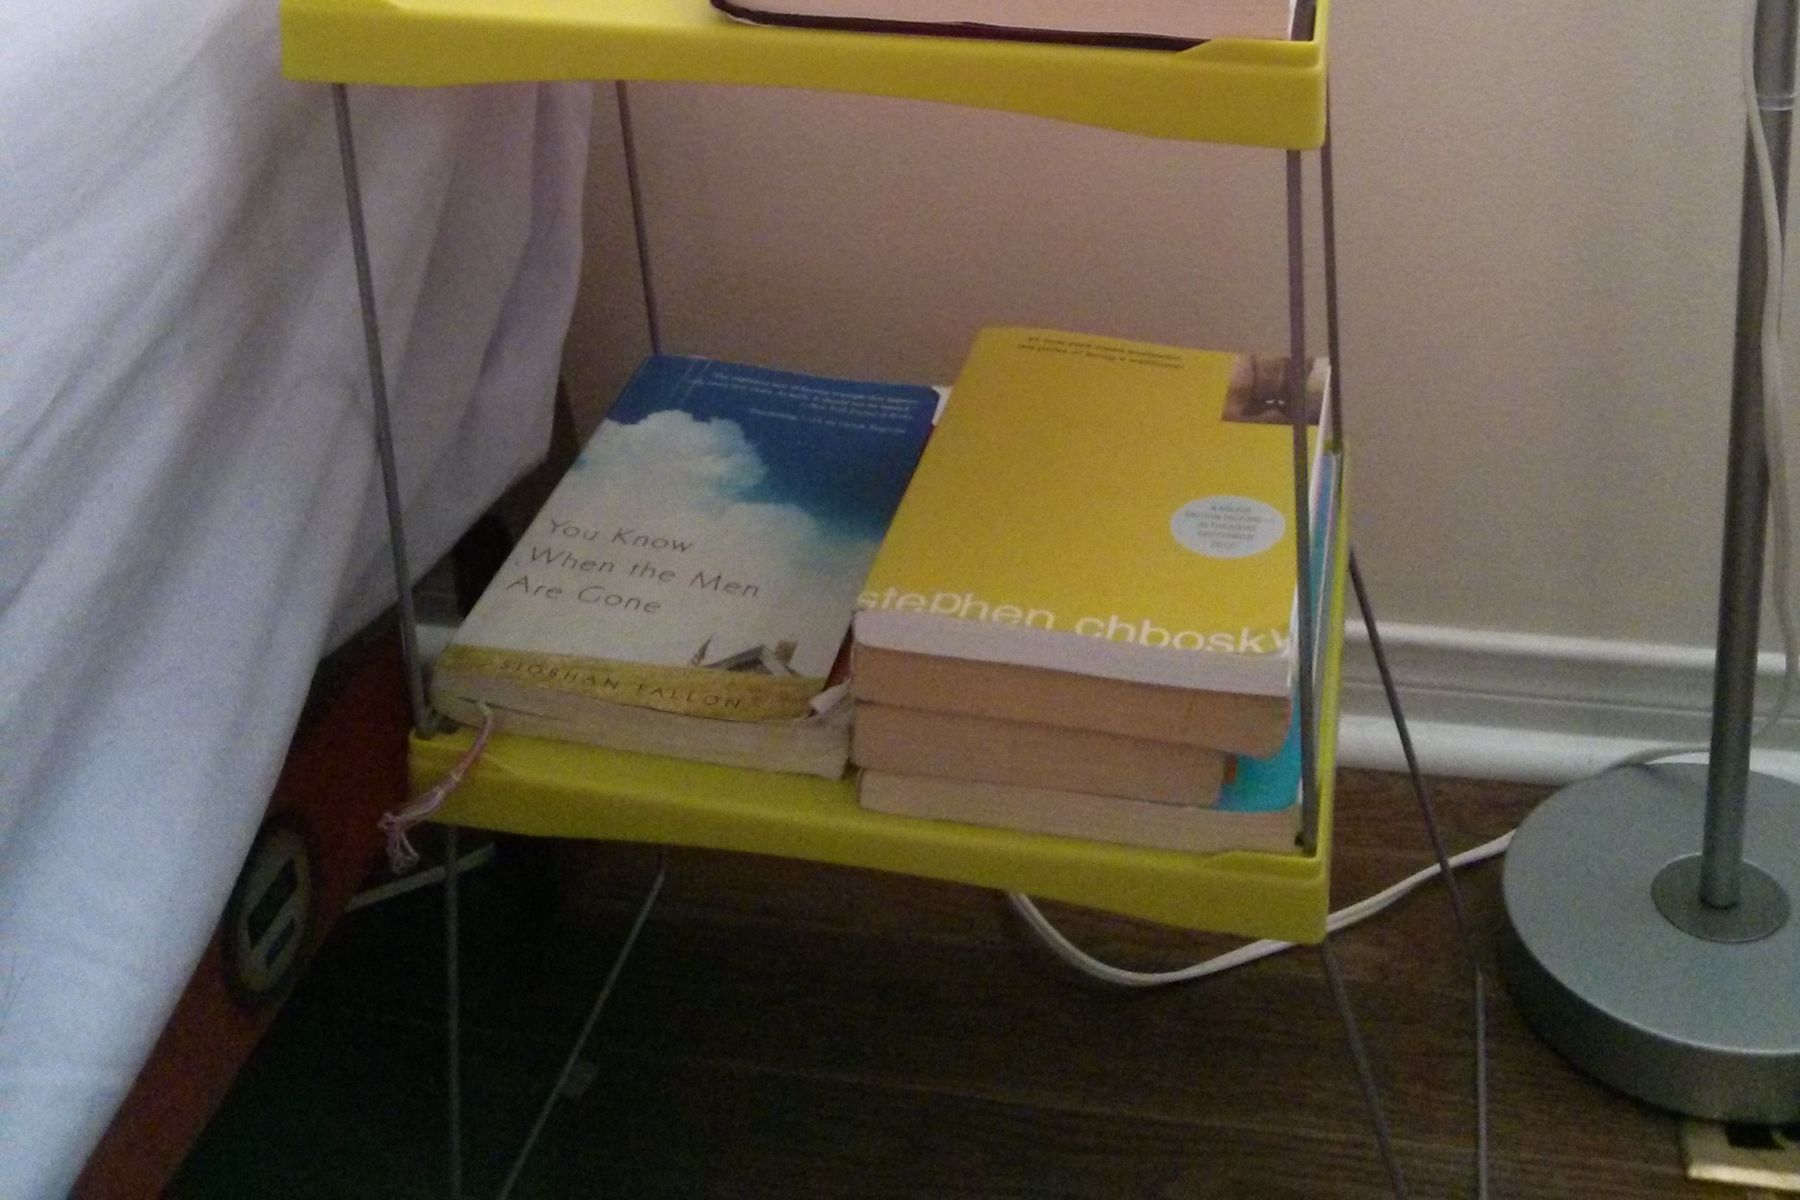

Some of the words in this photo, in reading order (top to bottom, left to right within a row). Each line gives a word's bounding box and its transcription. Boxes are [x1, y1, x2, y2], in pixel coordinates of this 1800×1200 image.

[550, 519, 599, 542] You
[611, 528, 693, 552] Know
[530, 546, 615, 573] When
[629, 563, 677, 583] the
[689, 571, 761, 598] Men
[506, 575, 563, 600] Are
[578, 585, 662, 614] Gone
[856, 587, 1056, 630] stephen
[1074, 614, 1291, 654] chbosky
[500, 660, 620, 690] SIOBHAN
